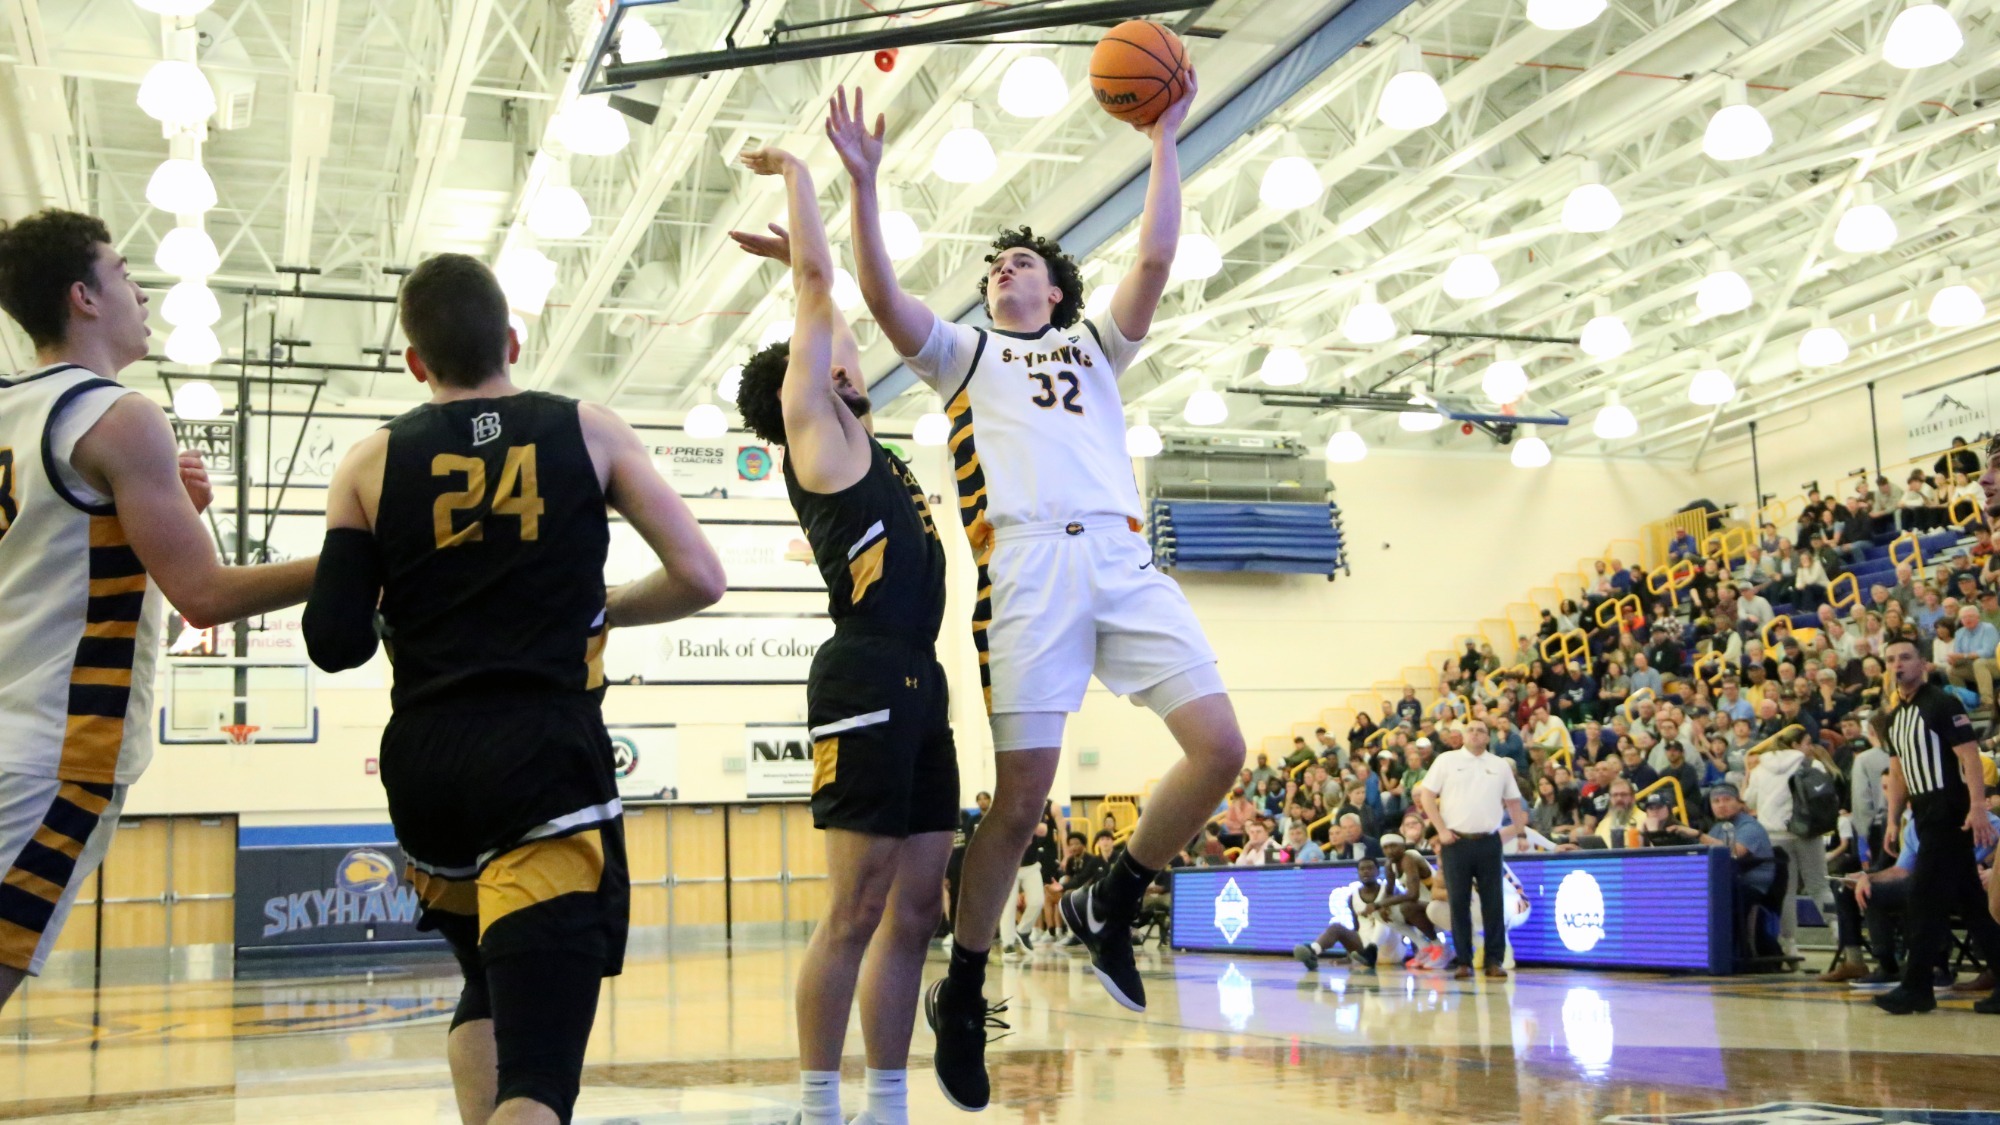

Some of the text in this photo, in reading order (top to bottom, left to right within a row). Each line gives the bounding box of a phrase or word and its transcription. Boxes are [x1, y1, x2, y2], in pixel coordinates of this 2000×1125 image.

[1028, 371, 1084, 416] 32
[211, 426, 230, 435] OF
[655, 446, 724, 457] EXPRESS
[673, 456, 723, 465] COACHES
[431, 443, 545, 549] 24
[678, 638, 820, 657] Bank of Color
[263, 886, 423, 938] SKYHAW
